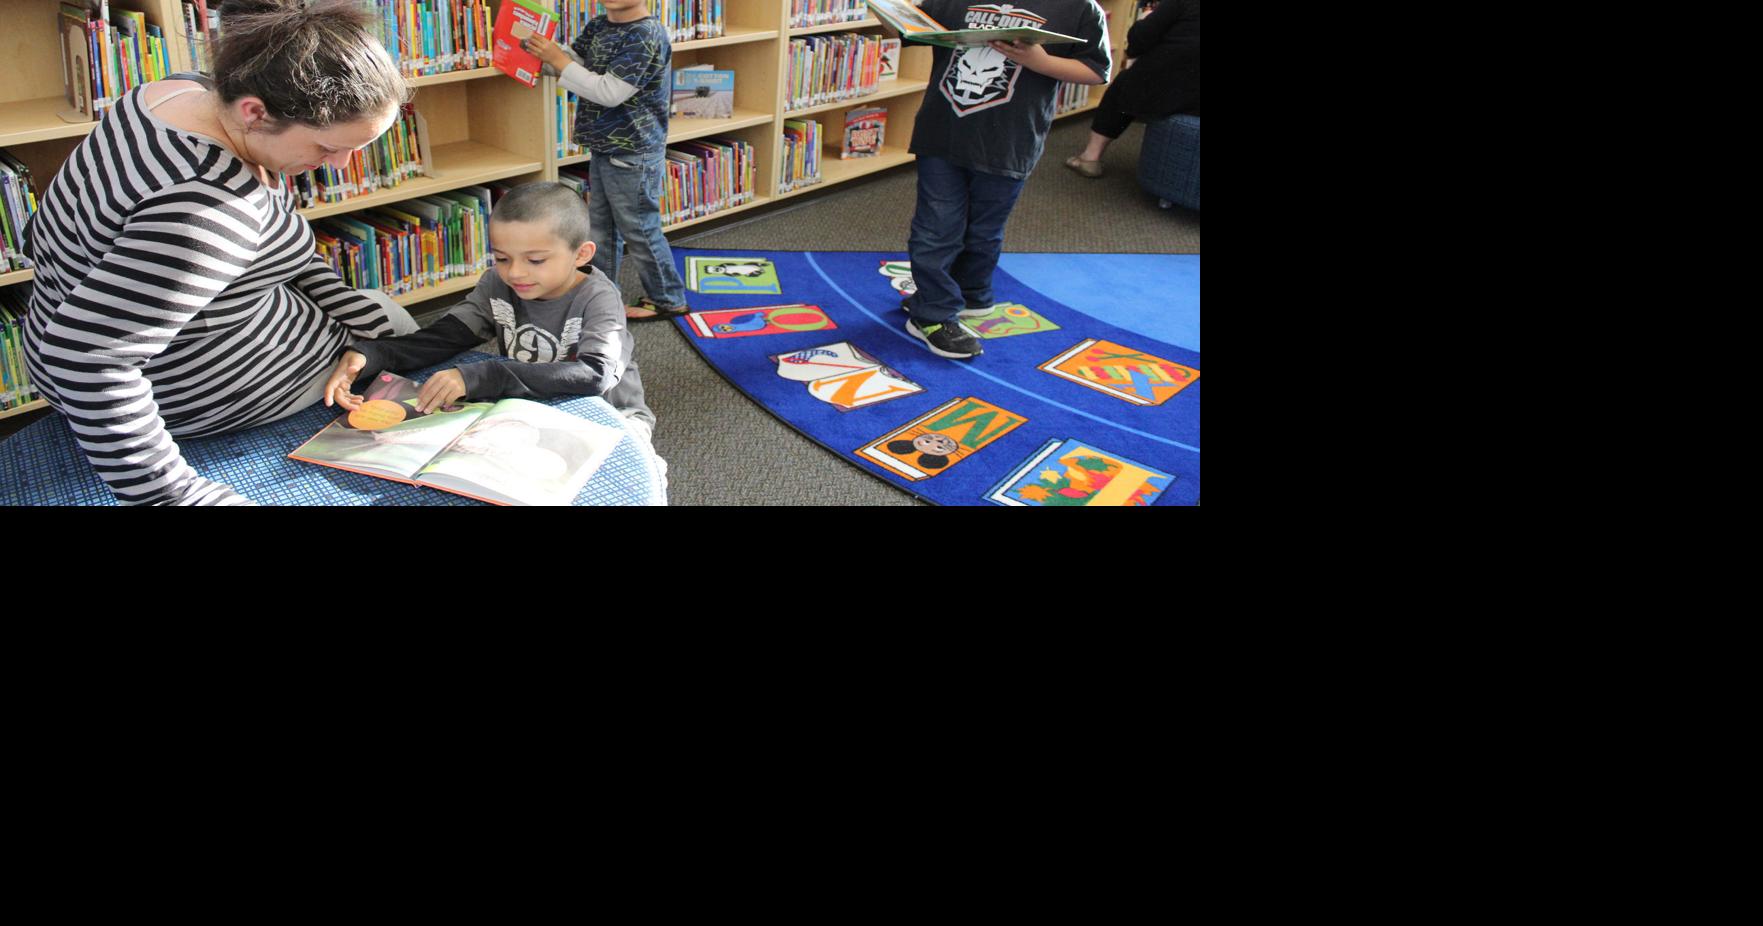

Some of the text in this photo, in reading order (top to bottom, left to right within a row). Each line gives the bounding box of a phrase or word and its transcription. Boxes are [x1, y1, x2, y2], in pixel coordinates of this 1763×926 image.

[965, 11, 995, 24] CALL
[998, 15, 1043, 29] DUTY
[700, 276, 779, 294] P
[768, 307, 828, 331] O
[813, 369, 913, 408] N
[1108, 370, 1178, 400] X
[925, 400, 1016, 450] M
